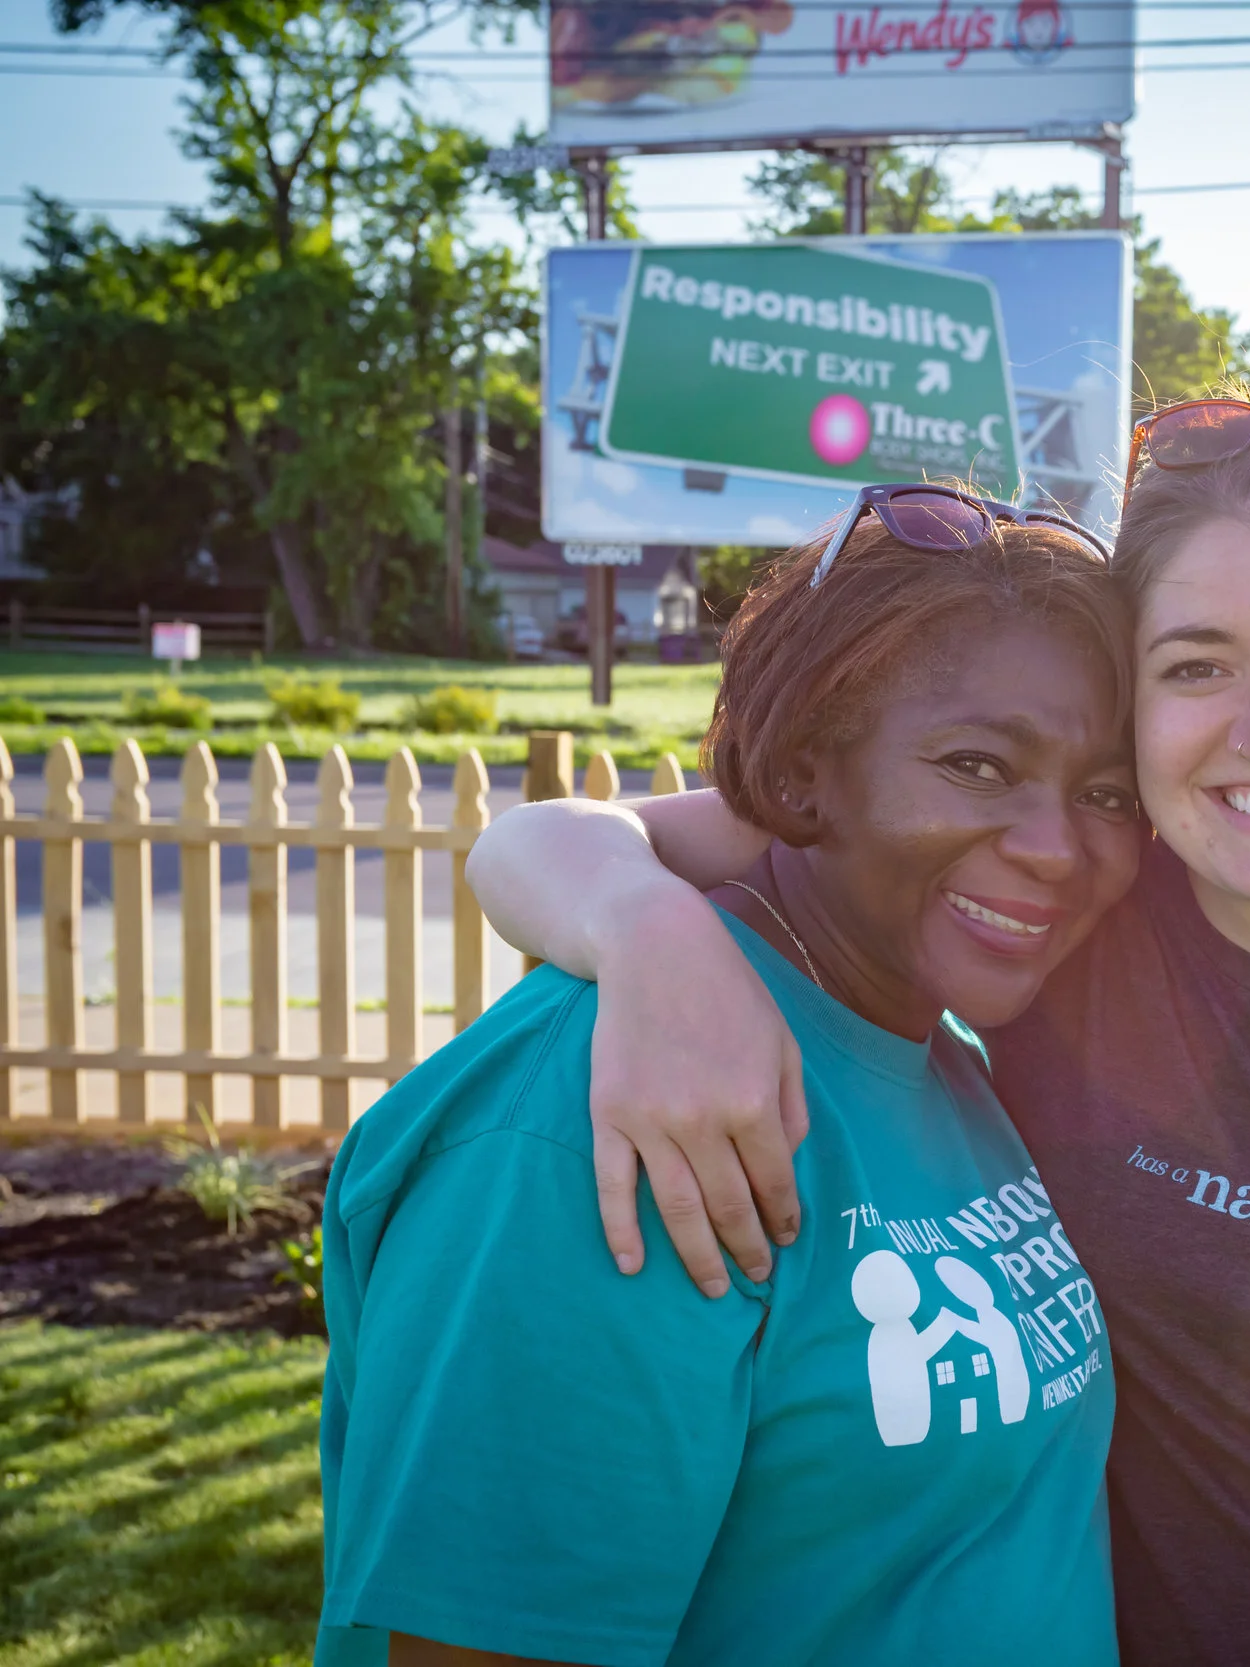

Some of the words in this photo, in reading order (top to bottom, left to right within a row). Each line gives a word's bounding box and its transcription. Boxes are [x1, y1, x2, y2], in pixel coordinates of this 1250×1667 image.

[836, 0, 996, 76] Wendy's
[641, 265, 990, 362] Responsibility
[709, 336, 809, 378] NEXT
[816, 351, 896, 389] EXIT
[870, 402, 1005, 451] Three-C
[1126, 1145, 1170, 1177] has
[1171, 1167, 1189, 1184] a
[840, 1202, 882, 1250] 7th
